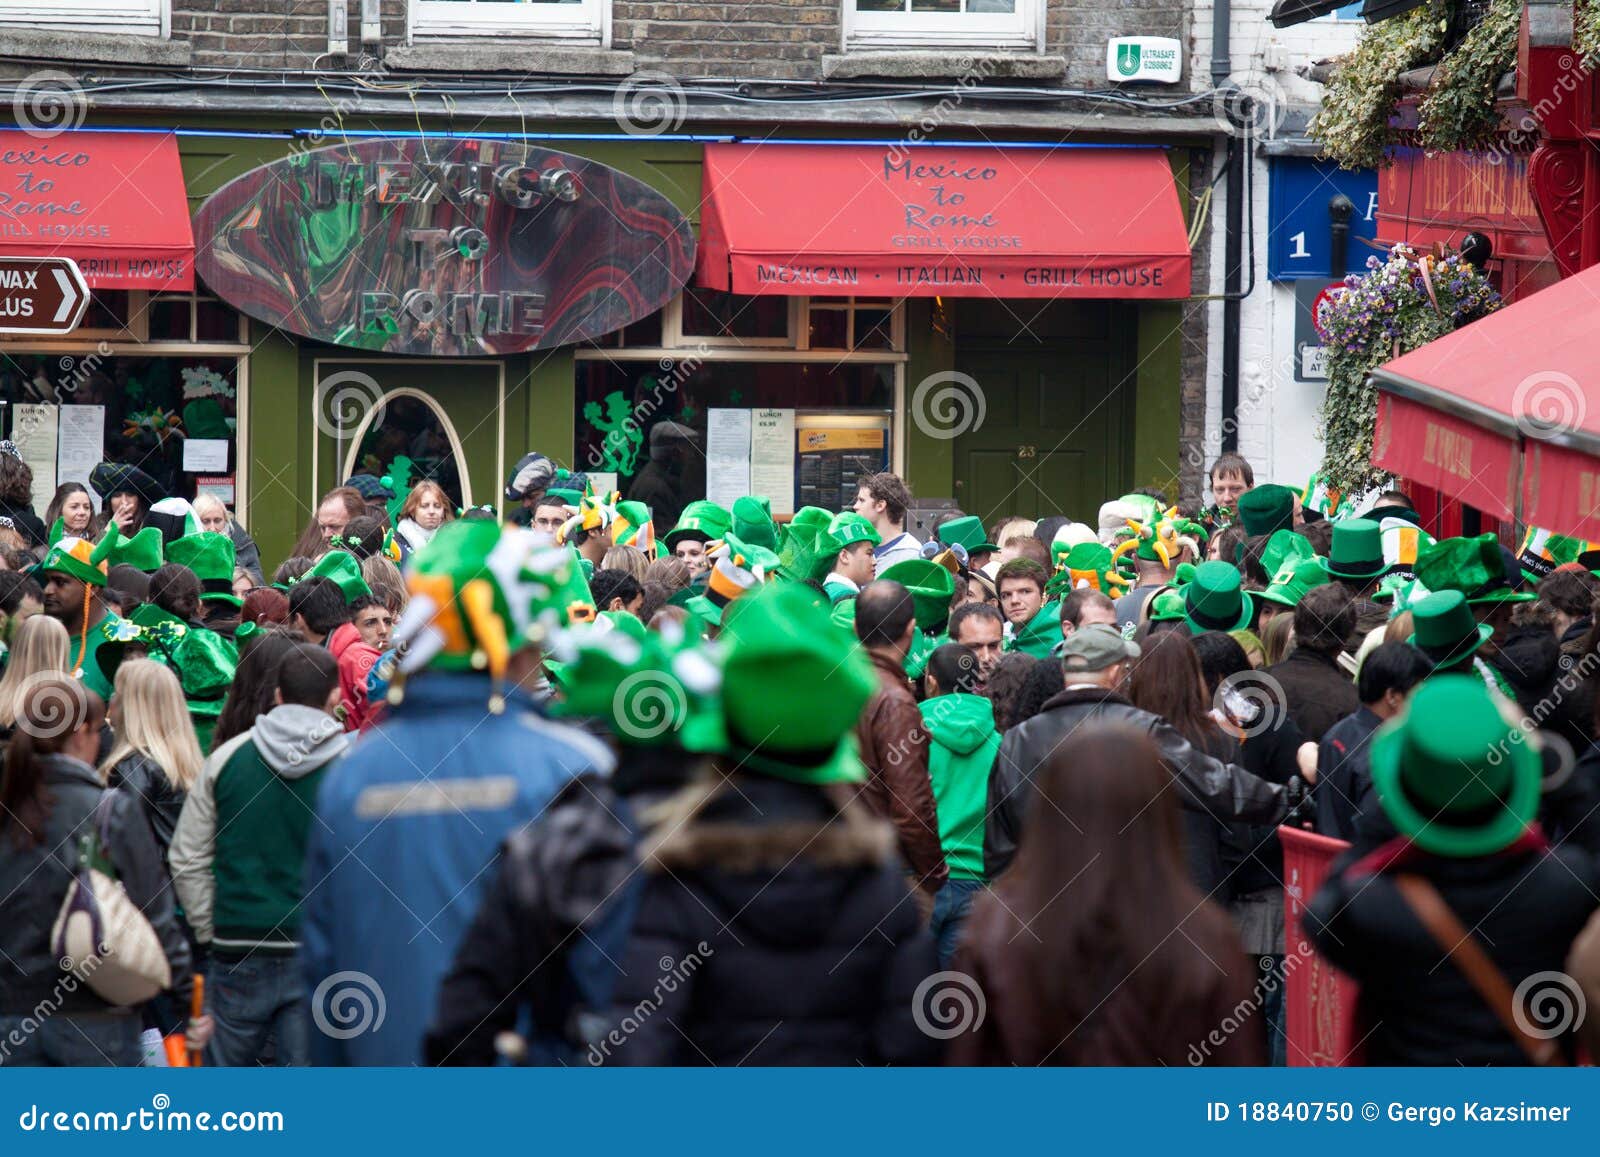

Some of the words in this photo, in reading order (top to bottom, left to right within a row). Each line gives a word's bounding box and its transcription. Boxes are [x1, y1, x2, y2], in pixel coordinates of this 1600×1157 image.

[0, 145, 90, 166] exico
[883, 155, 997, 181] Mexico
[16, 171, 55, 193] to
[929, 185, 966, 206] to
[904, 203, 999, 232] Rome
[0, 224, 33, 236] ILL
[39, 224, 111, 237] HOUSE
[891, 234, 946, 248] GRILL
[952, 235, 1023, 249] HOUSE
[404, 225, 490, 271] TO
[1289, 231, 1311, 258] 1
[77, 258, 123, 279] GRILL
[128, 259, 184, 279] HOUSE
[757, 264, 859, 285] MEXICAN
[897, 266, 983, 286] ITALIAN
[1023, 267, 1083, 287] GRILL
[1089, 267, 1163, 287] HOUSE
[359, 289, 546, 335] ROME
[1018, 445, 1036, 457] 23
